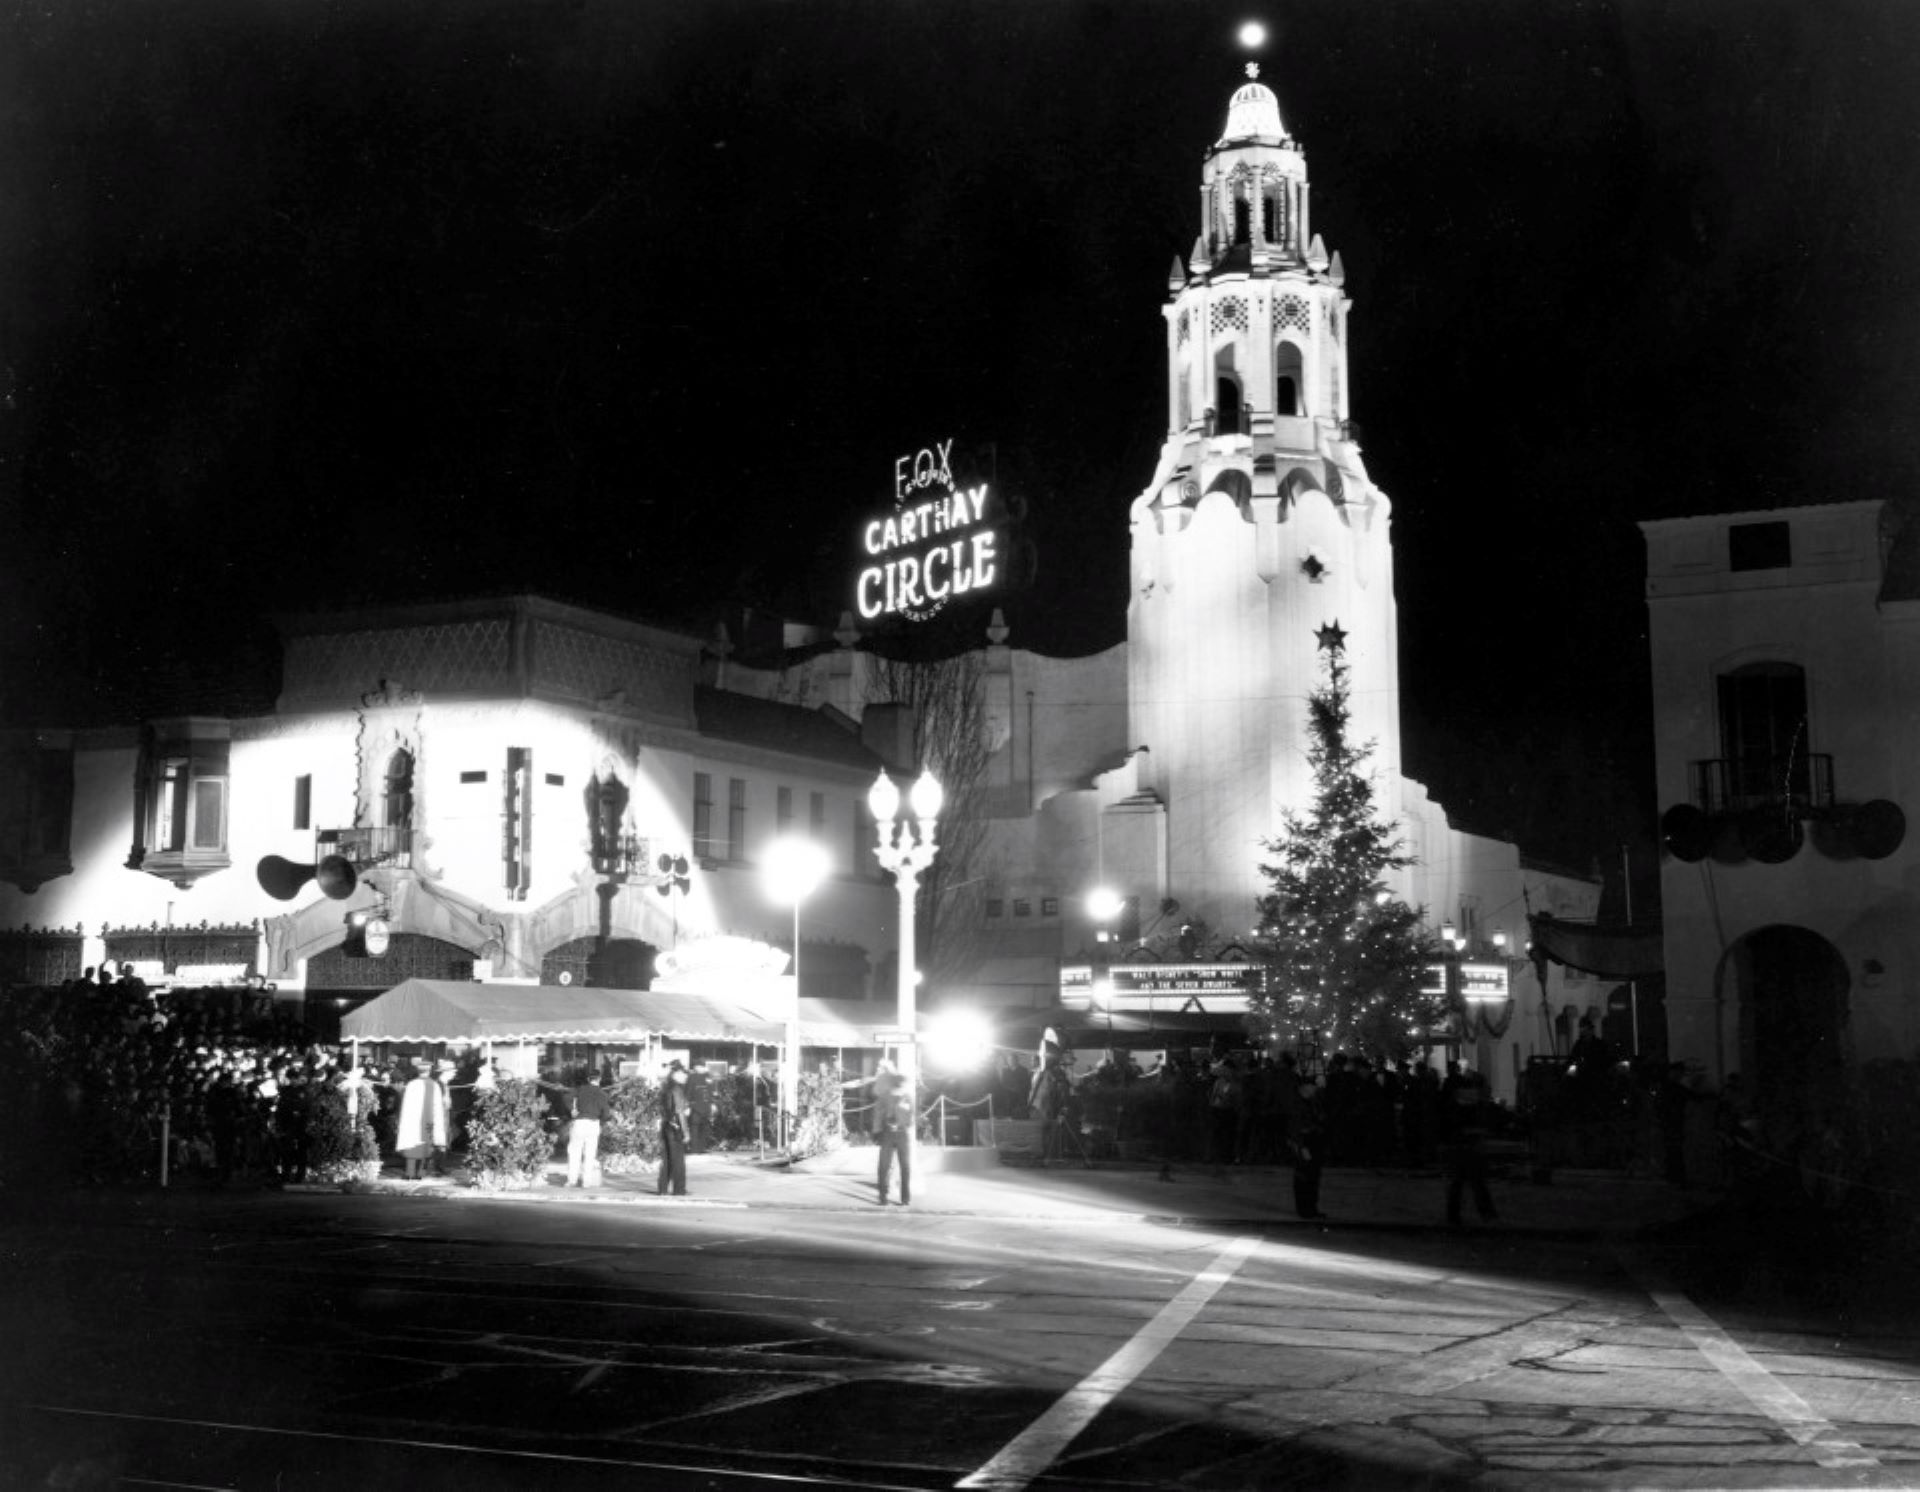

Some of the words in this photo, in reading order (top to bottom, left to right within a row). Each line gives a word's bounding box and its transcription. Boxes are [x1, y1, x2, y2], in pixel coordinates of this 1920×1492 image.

[895, 438, 953, 499] FOX
[864, 482, 989, 555] CARTHAY
[857, 530, 996, 619] CIRCLE
